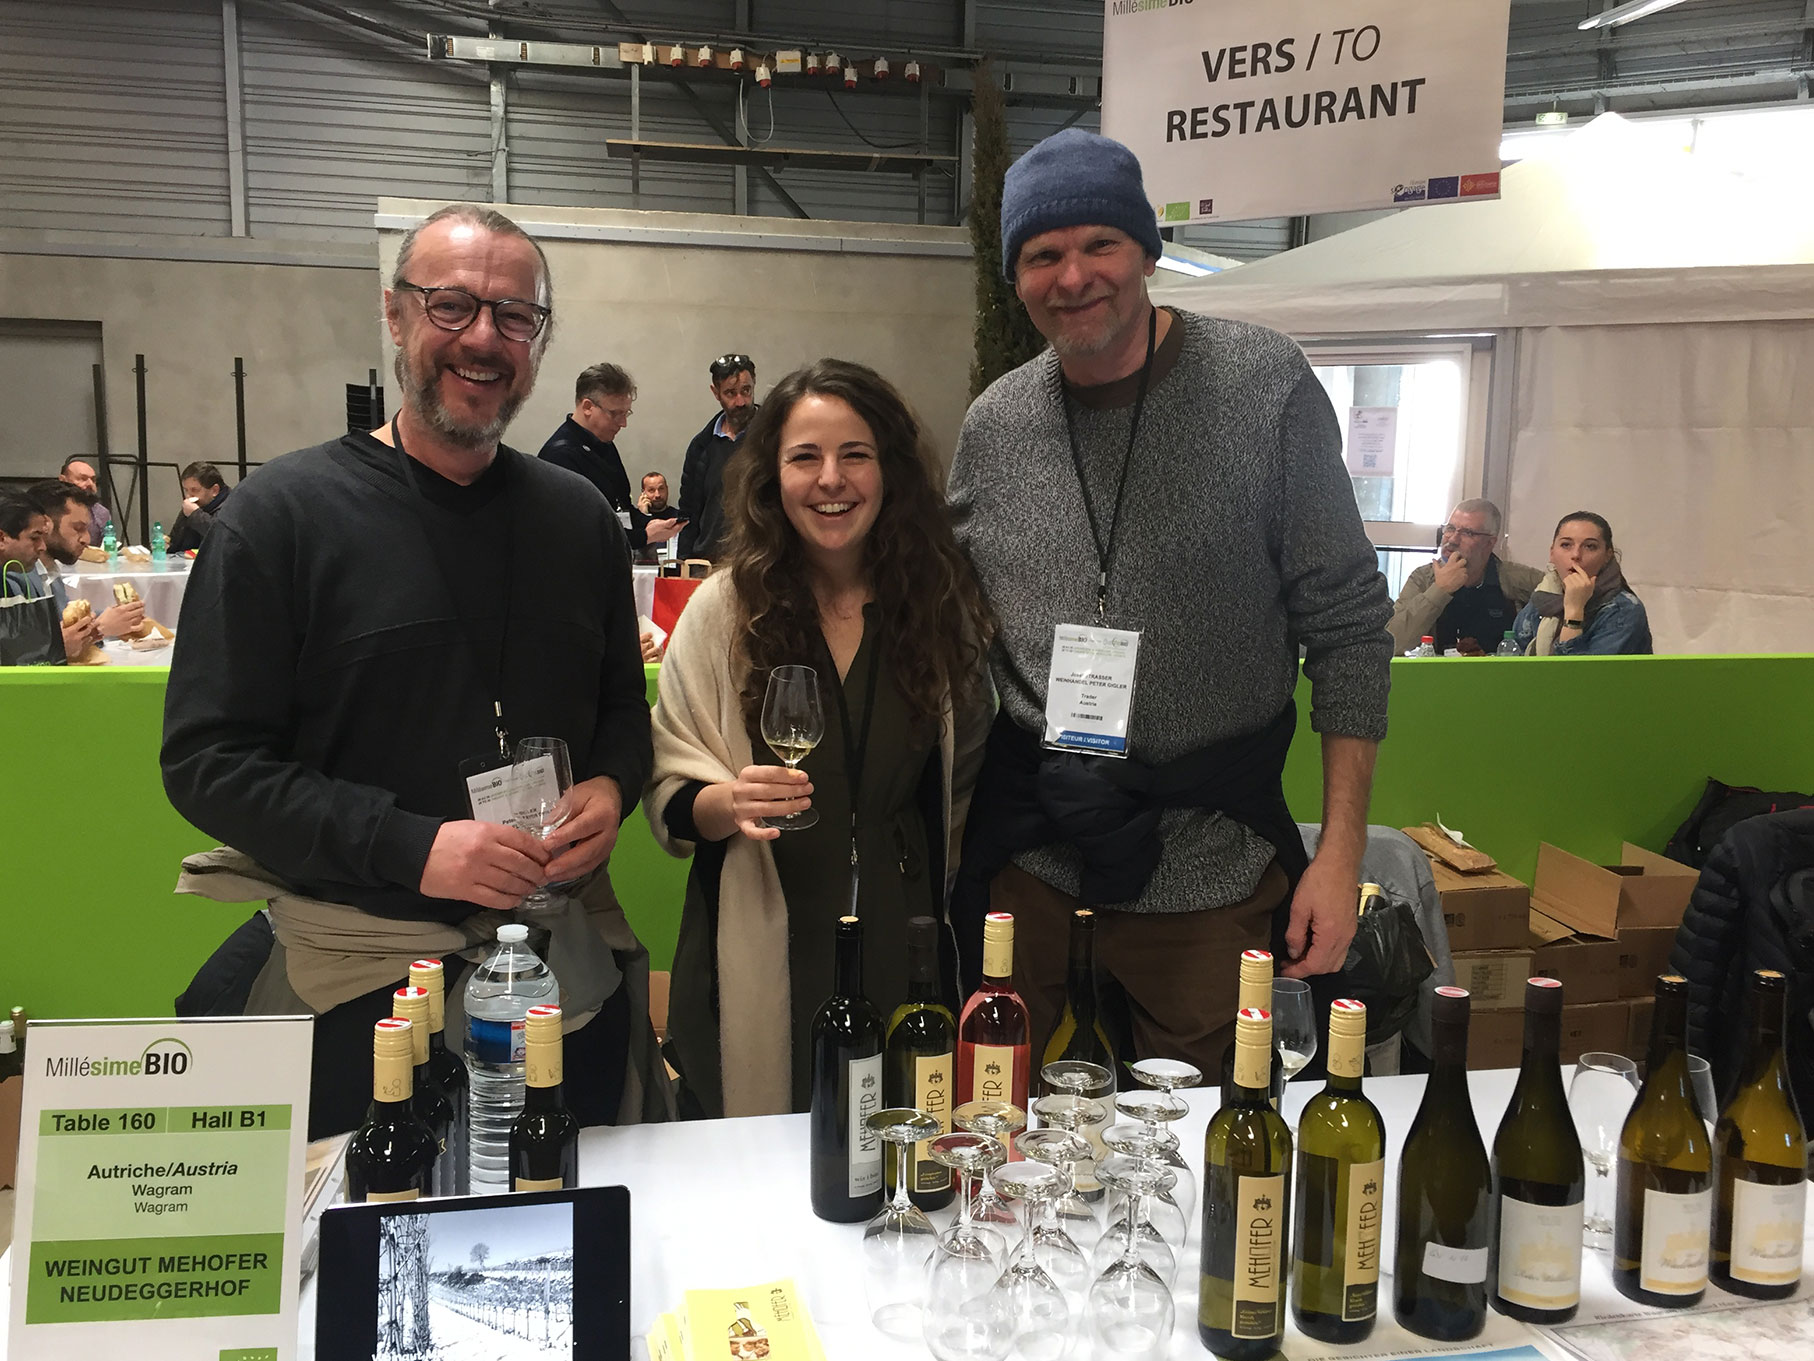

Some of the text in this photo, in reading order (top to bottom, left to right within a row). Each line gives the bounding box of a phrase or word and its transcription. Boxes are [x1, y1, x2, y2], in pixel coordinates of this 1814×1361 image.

[1201, 24, 1381, 83] VERS / TO
[1166, 78, 1426, 143] RESTAURANT
[1087, 737, 1110, 746] VISITOR
[52, 1110, 267, 1132] Table 160 Hall B1
[87, 1161, 239, 1180] Autriche/Austria
[132, 1183, 193, 1199] Wagram
[134, 1201, 188, 1215] Wagram
[45, 1252, 268, 1278] WEINGUT MEHOFER
[60, 1279, 251, 1303] NEUDEGGERHOF
